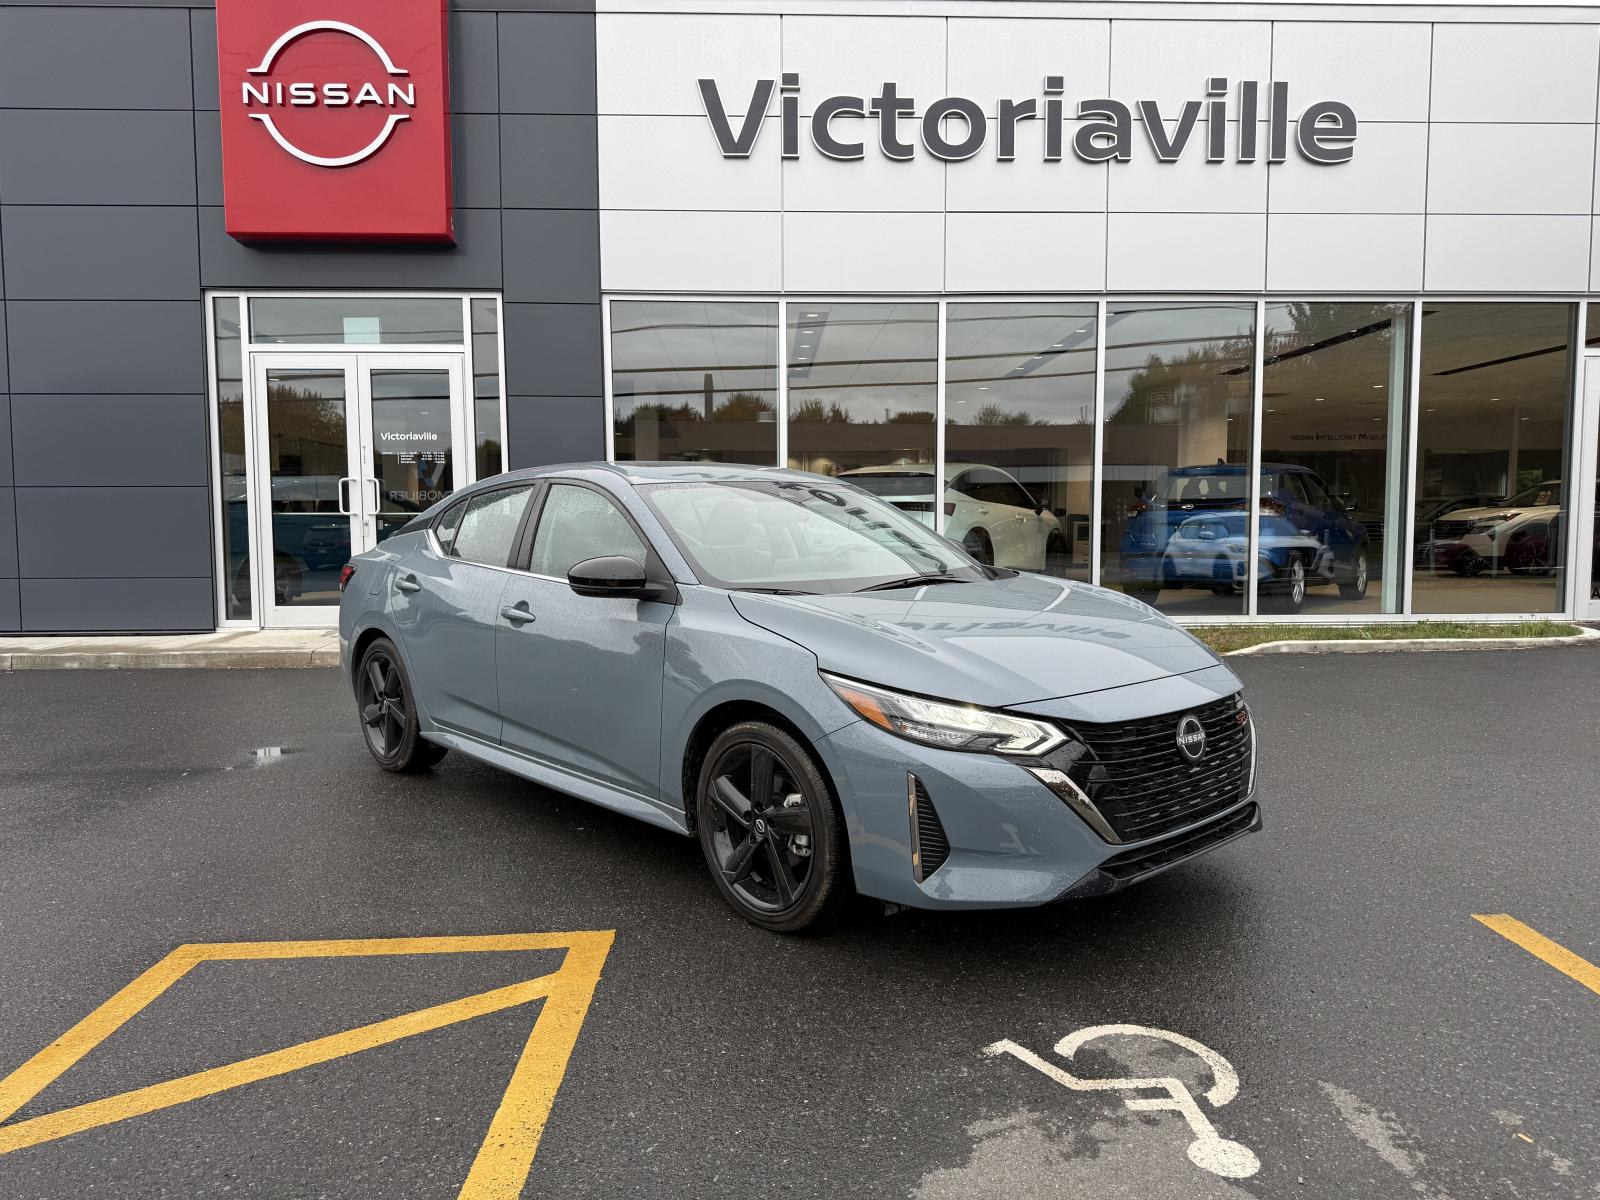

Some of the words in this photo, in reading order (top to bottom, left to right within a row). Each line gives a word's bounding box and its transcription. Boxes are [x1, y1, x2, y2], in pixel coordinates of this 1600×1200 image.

[242, 82, 416, 107] NISSAN
[697, 72, 1358, 165] Victoriaville
[380, 431, 438, 441] Victoriaville
[1177, 731, 1206, 745] NISSAN
